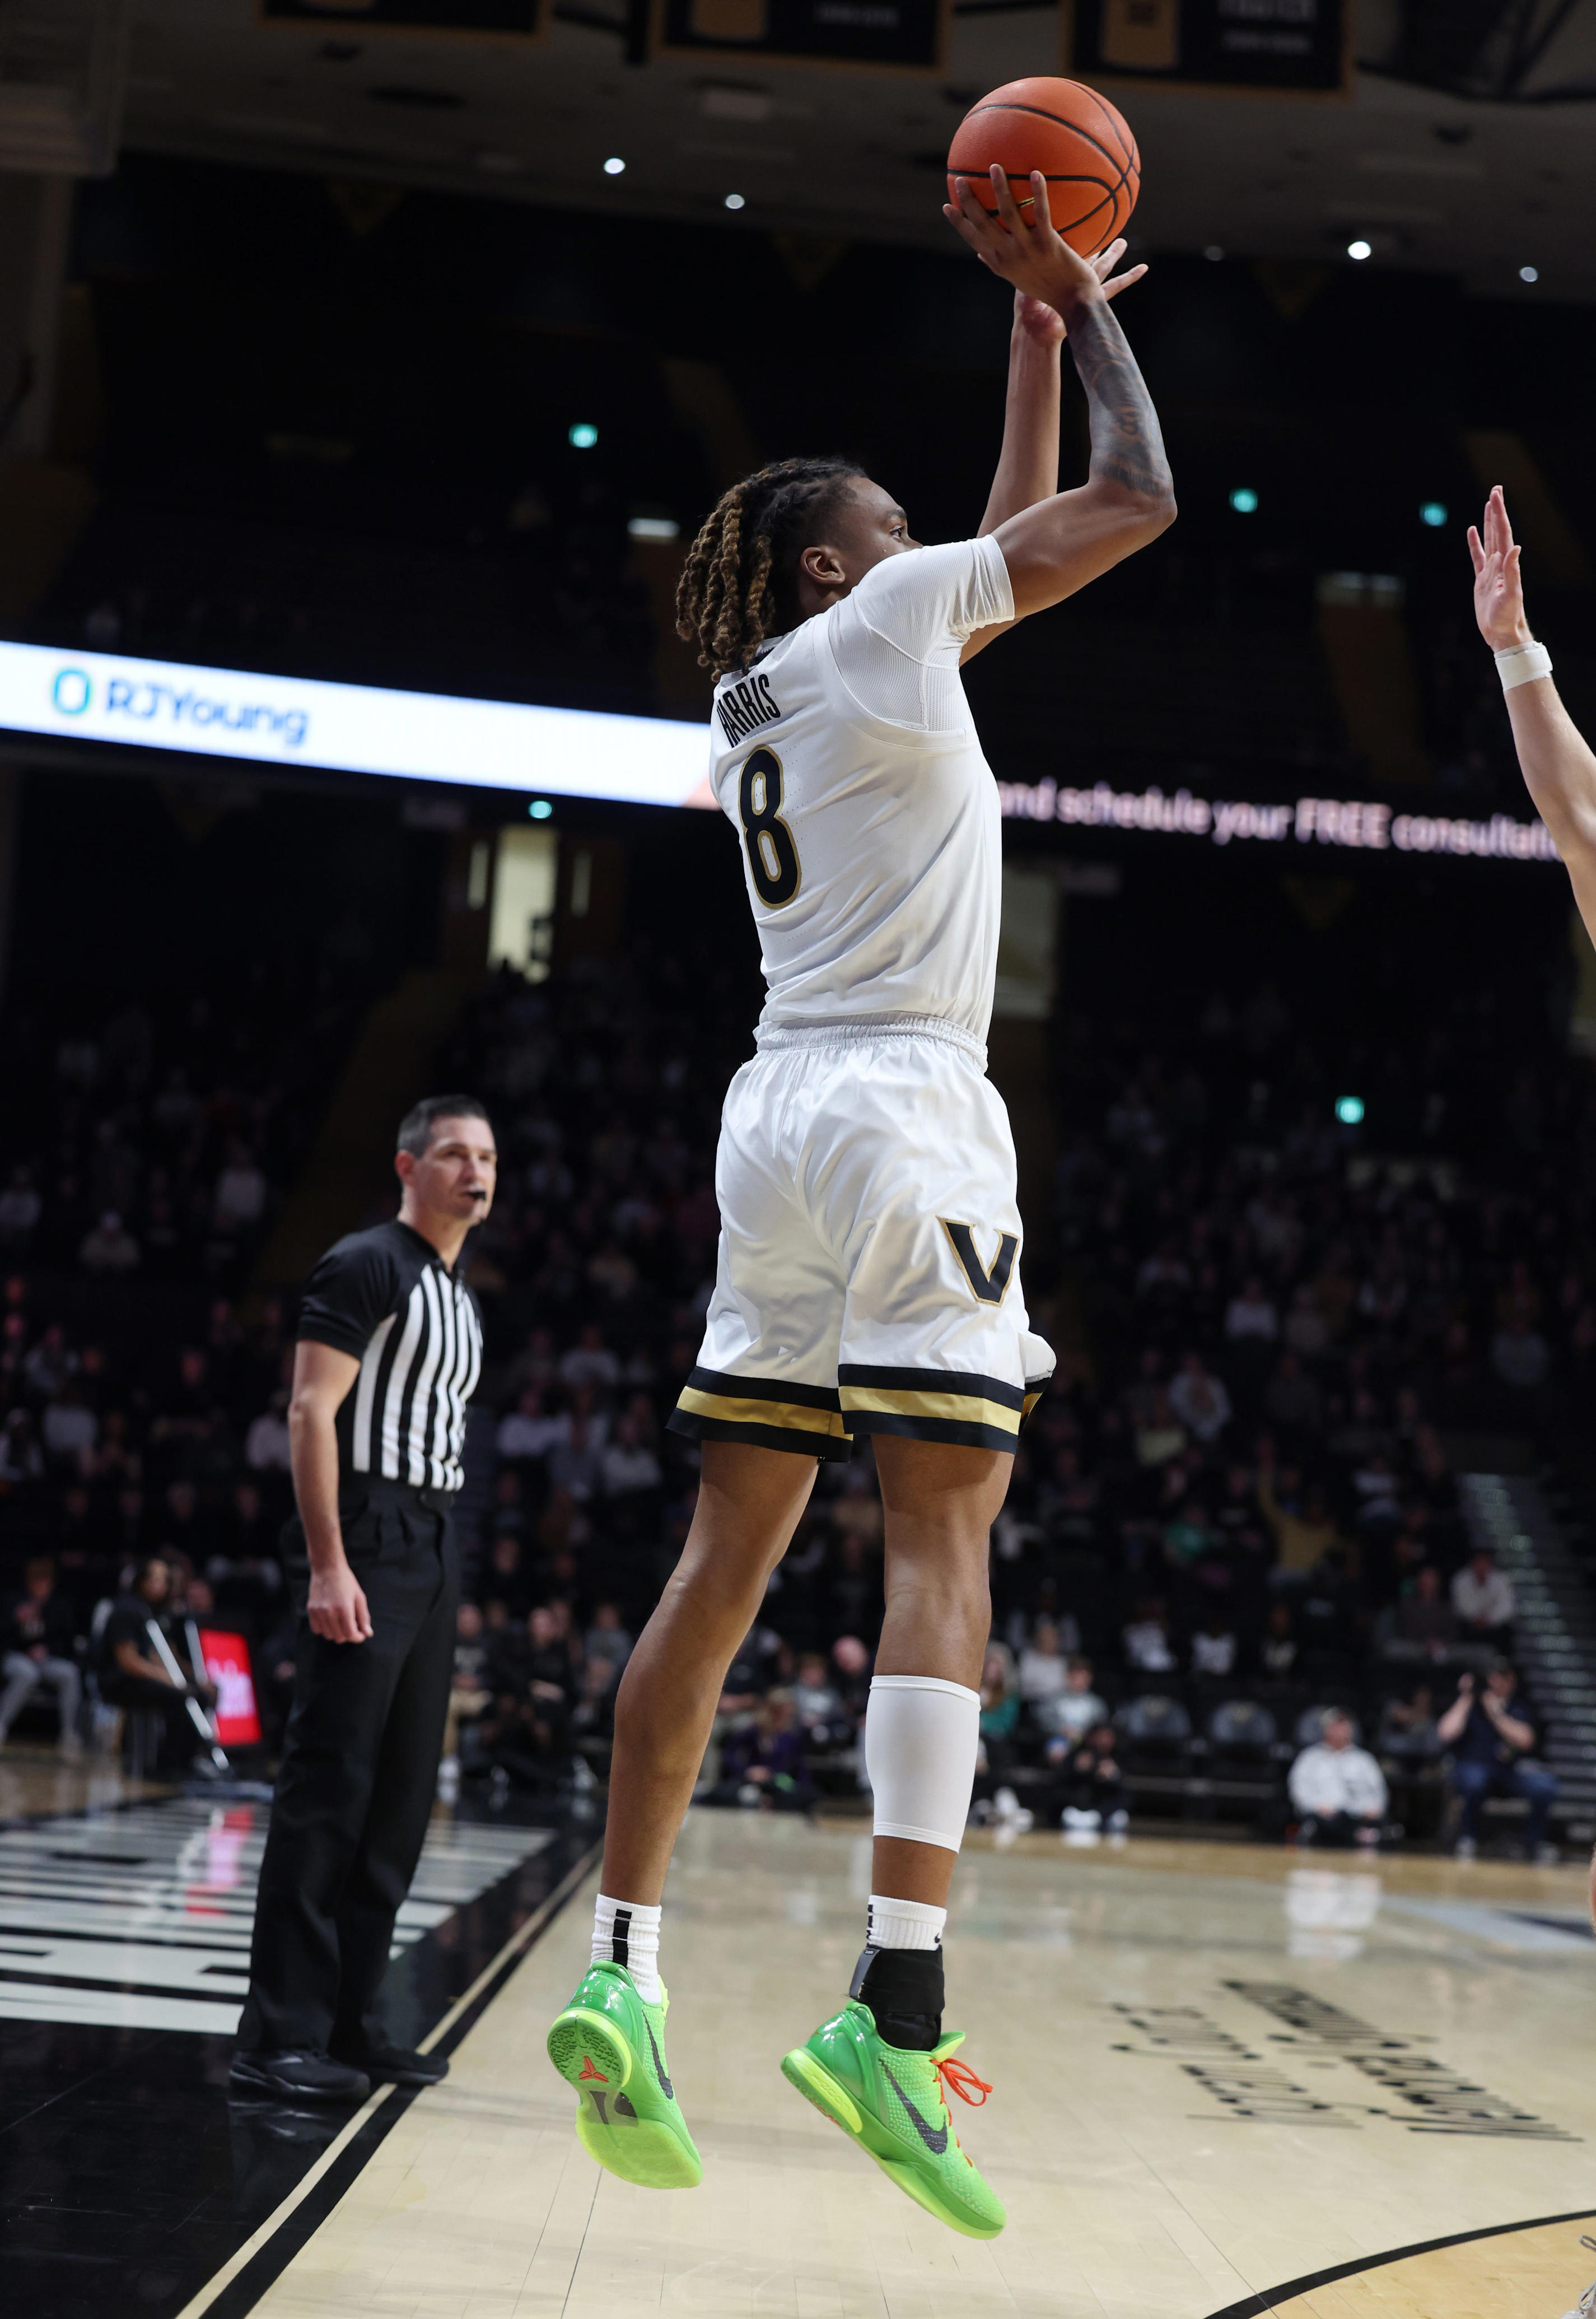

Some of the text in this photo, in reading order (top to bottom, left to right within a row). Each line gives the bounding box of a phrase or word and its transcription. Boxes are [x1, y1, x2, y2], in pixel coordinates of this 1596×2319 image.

[717, 674, 781, 748] HARRIS
[739, 744, 802, 909] 8
[1058, 780, 1211, 835] schedule
[1211, 800, 1295, 845] your
[1295, 798, 1391, 849] FREE
[1392, 812, 1566, 863] consultati
[935, 1215, 1020, 1307] V
